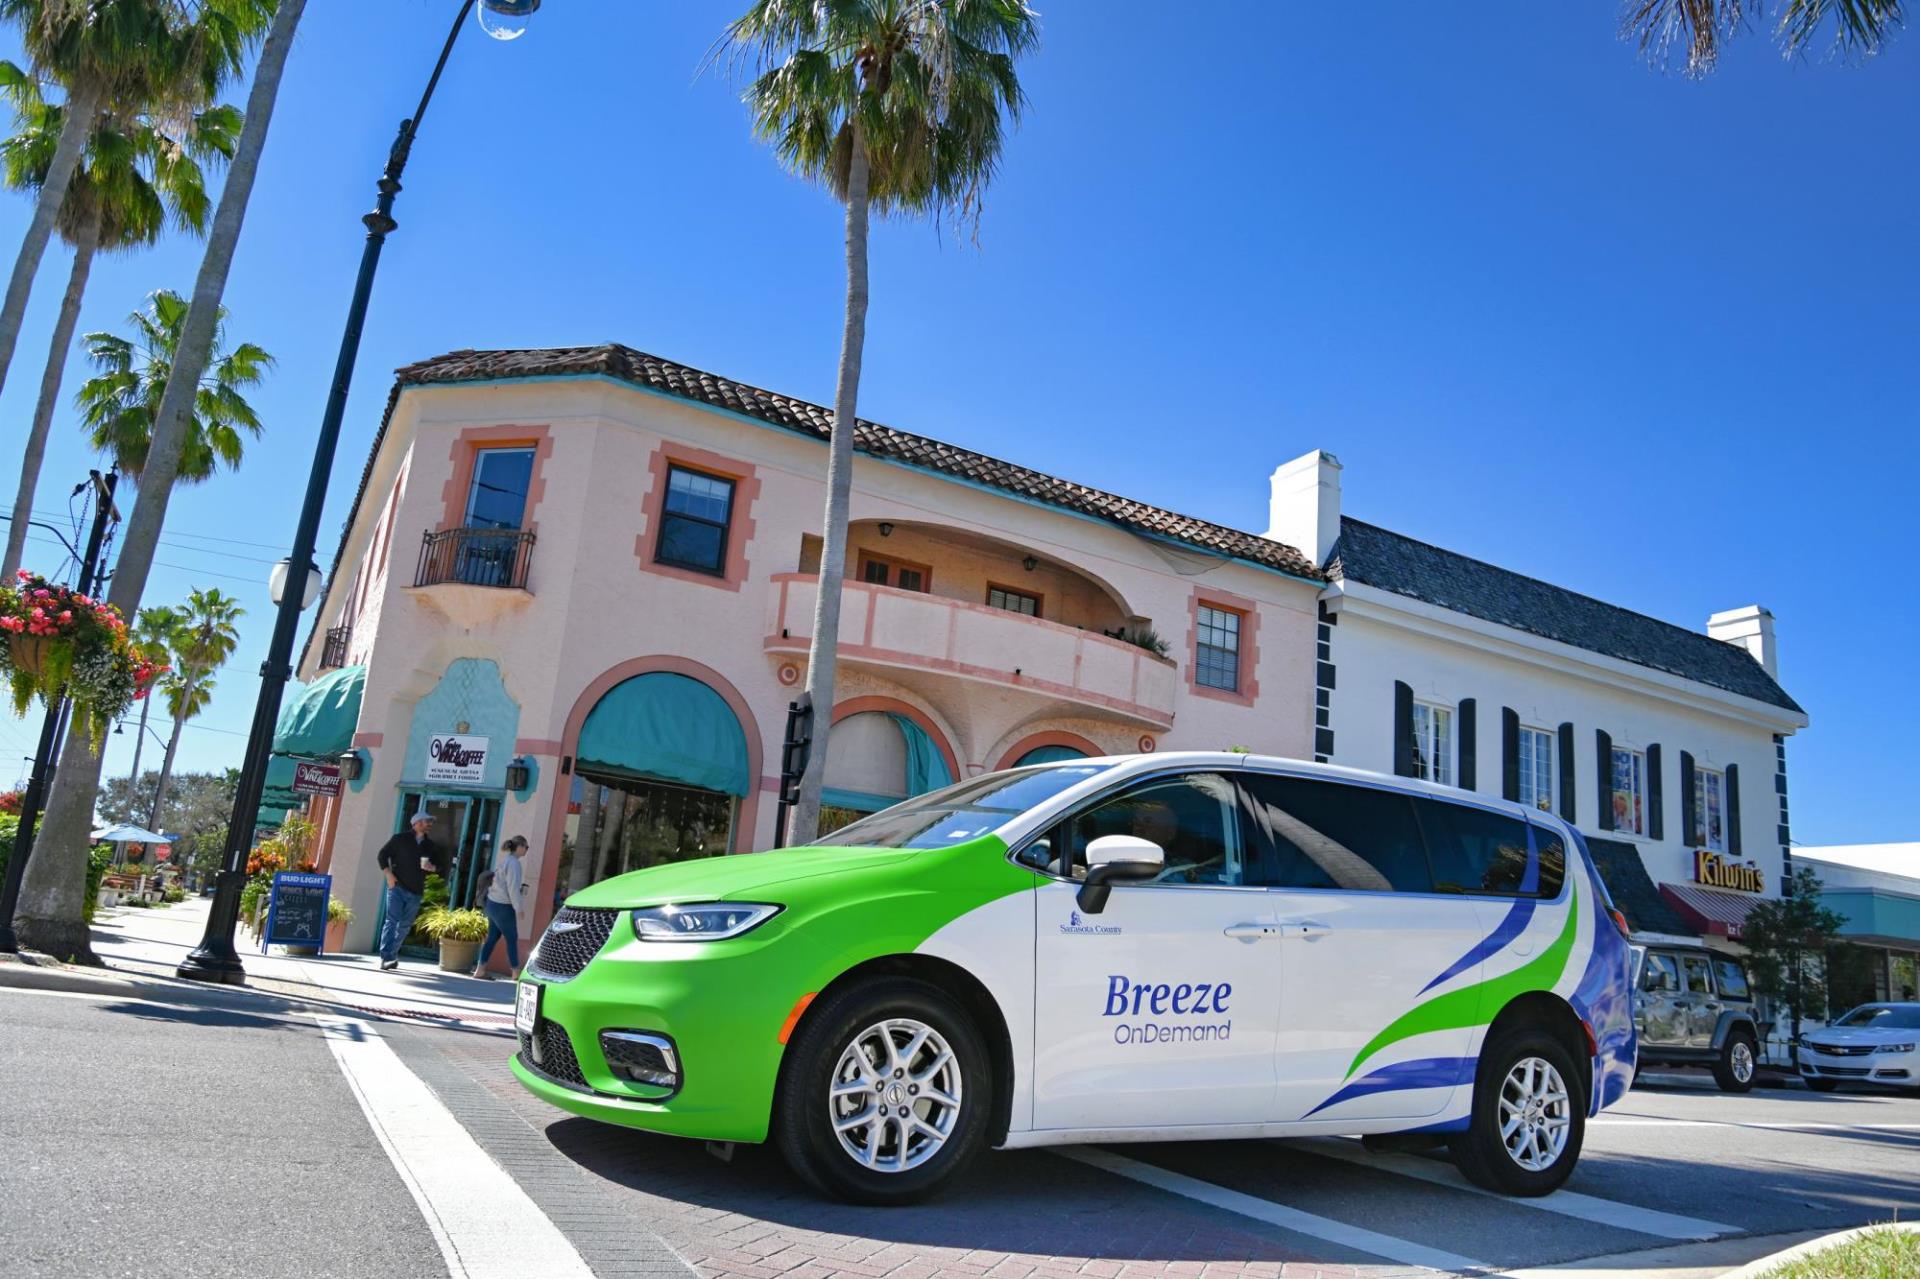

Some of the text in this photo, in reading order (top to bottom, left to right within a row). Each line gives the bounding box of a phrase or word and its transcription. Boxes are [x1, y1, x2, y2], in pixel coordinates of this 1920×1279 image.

[281, 875, 326, 885] BUD LIGHT
[1060, 924, 1122, 935] Sarasota County
[1102, 975, 1232, 1016] Breeze
[1114, 1019, 1231, 1044] OnDemand
